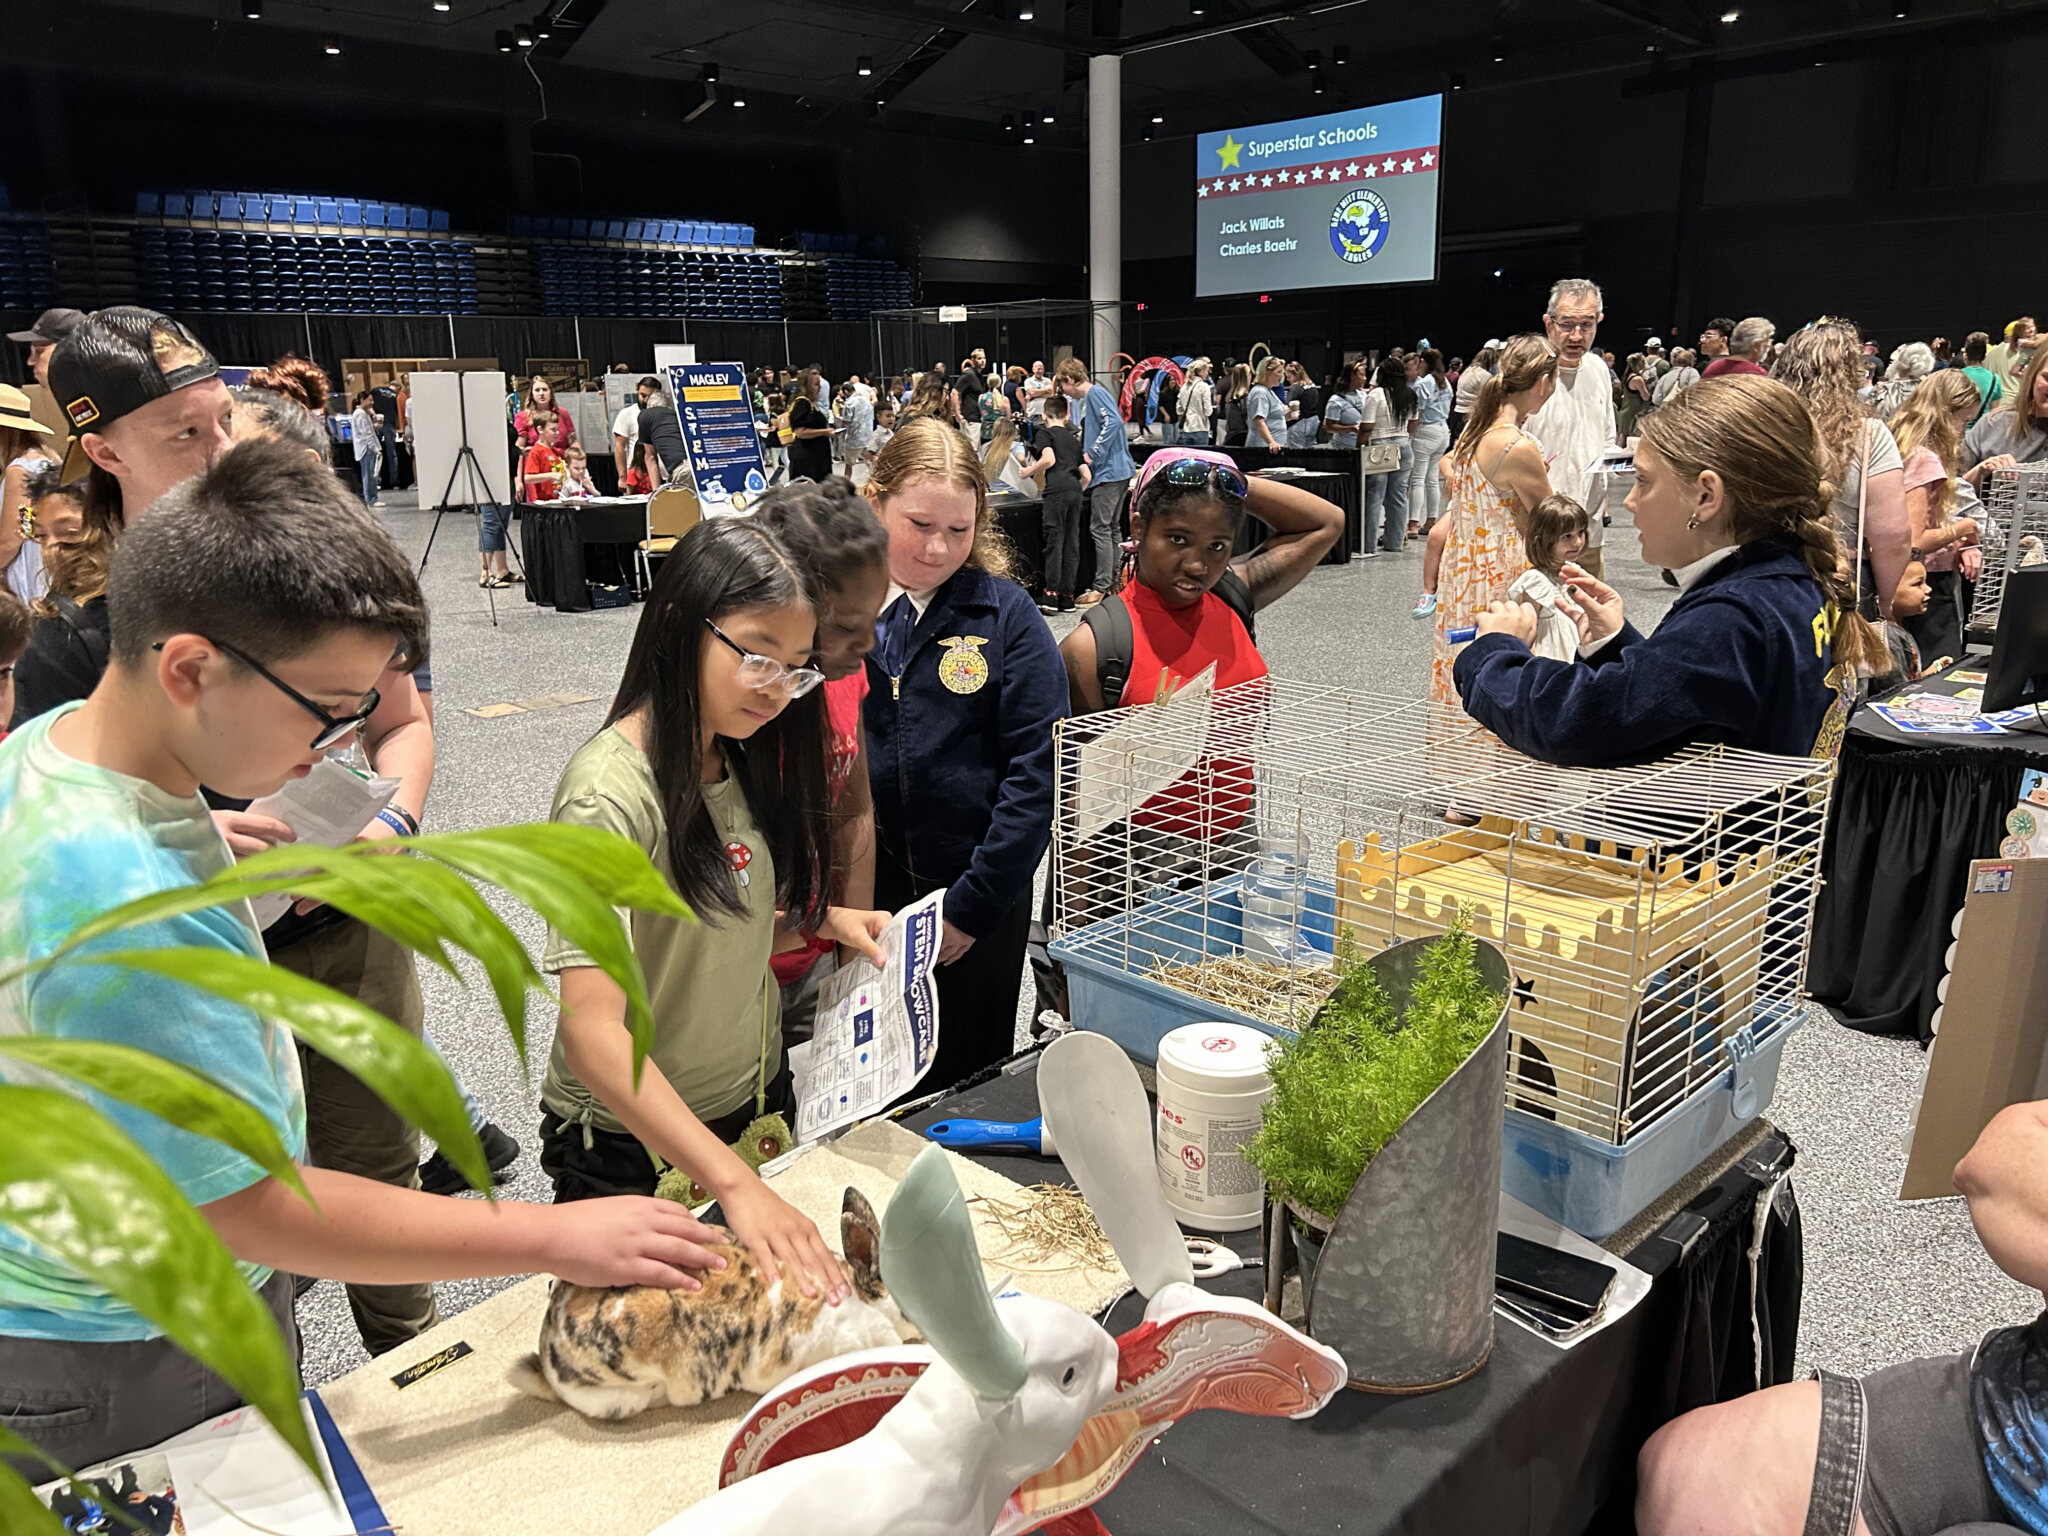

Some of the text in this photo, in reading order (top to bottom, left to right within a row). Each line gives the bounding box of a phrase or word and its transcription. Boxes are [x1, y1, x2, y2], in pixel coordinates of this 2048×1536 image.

[1248, 122, 1378, 158] Superstar Schools
[1340, 192, 1356, 209] WITT
[1356, 190, 1389, 222] ELEMENTARY
[1219, 215, 1285, 235] Jack Willats
[1220, 237, 1298, 257] Charles Baehr
[1343, 248, 1373, 263] EAGLES
[688, 373, 729, 386] MAGLEV
[910, 916, 928, 1064] STEM SHOWCASE
